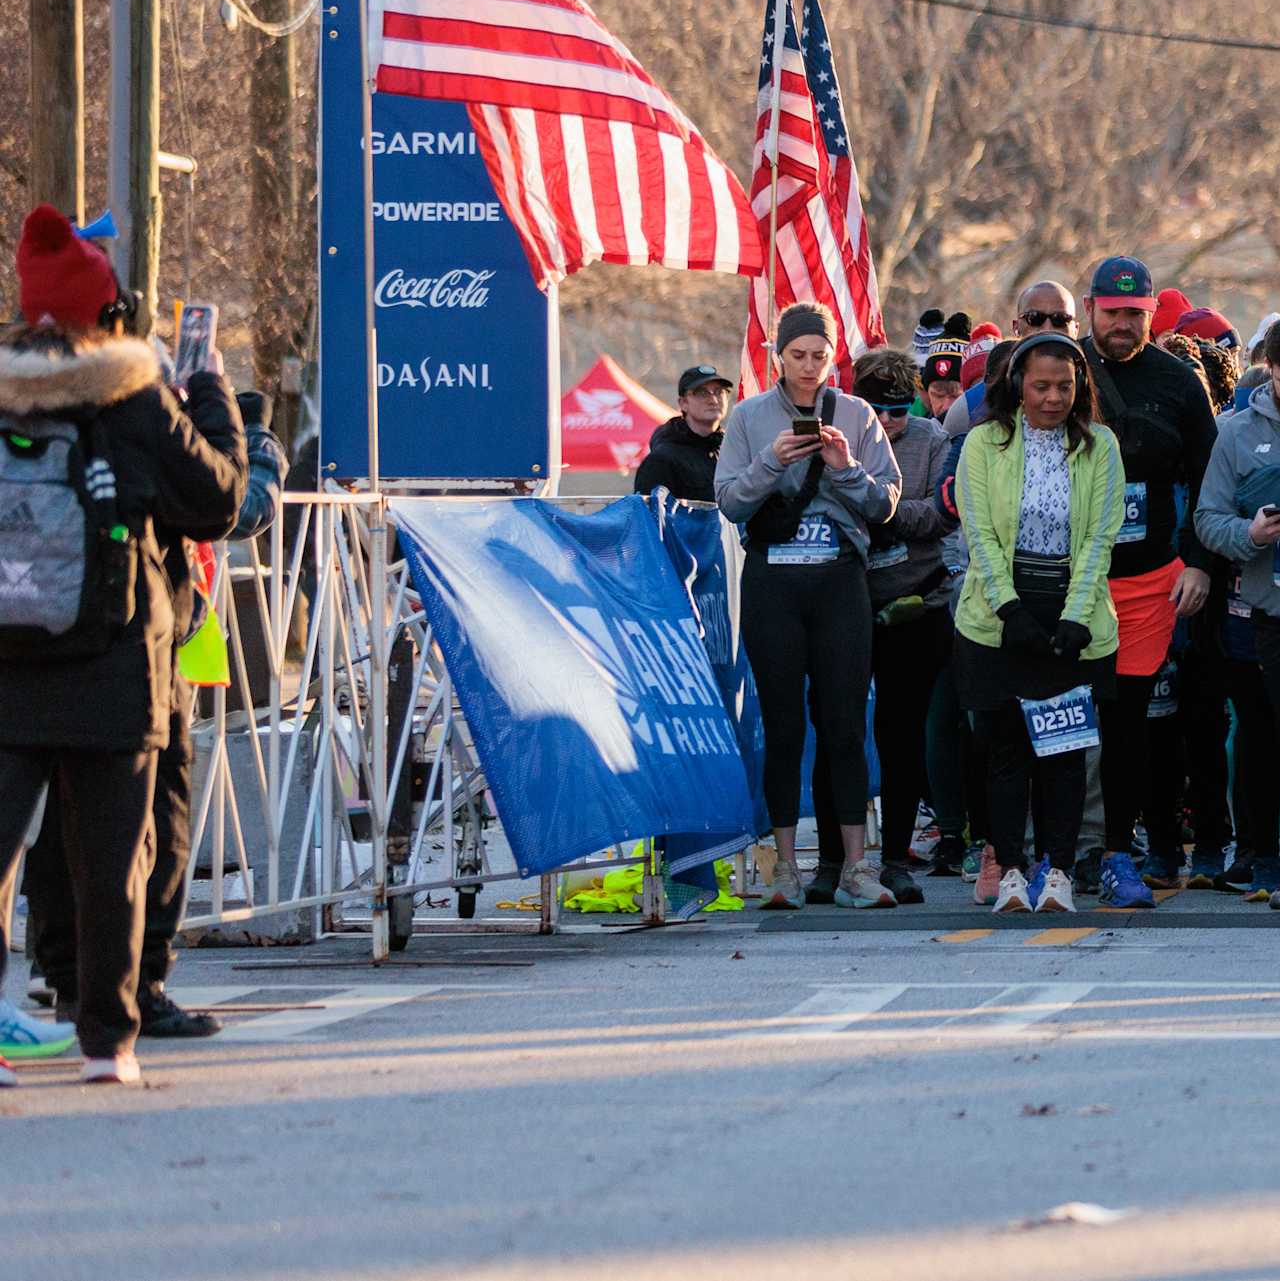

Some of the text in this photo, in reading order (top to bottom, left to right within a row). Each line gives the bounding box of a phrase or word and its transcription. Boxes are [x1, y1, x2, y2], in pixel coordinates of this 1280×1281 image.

[361, 131, 477, 155] GARMI
[374, 268, 497, 308] Coca-Cola
[376, 356, 490, 394] DASANI
[1031, 705, 1086, 733] D2315
